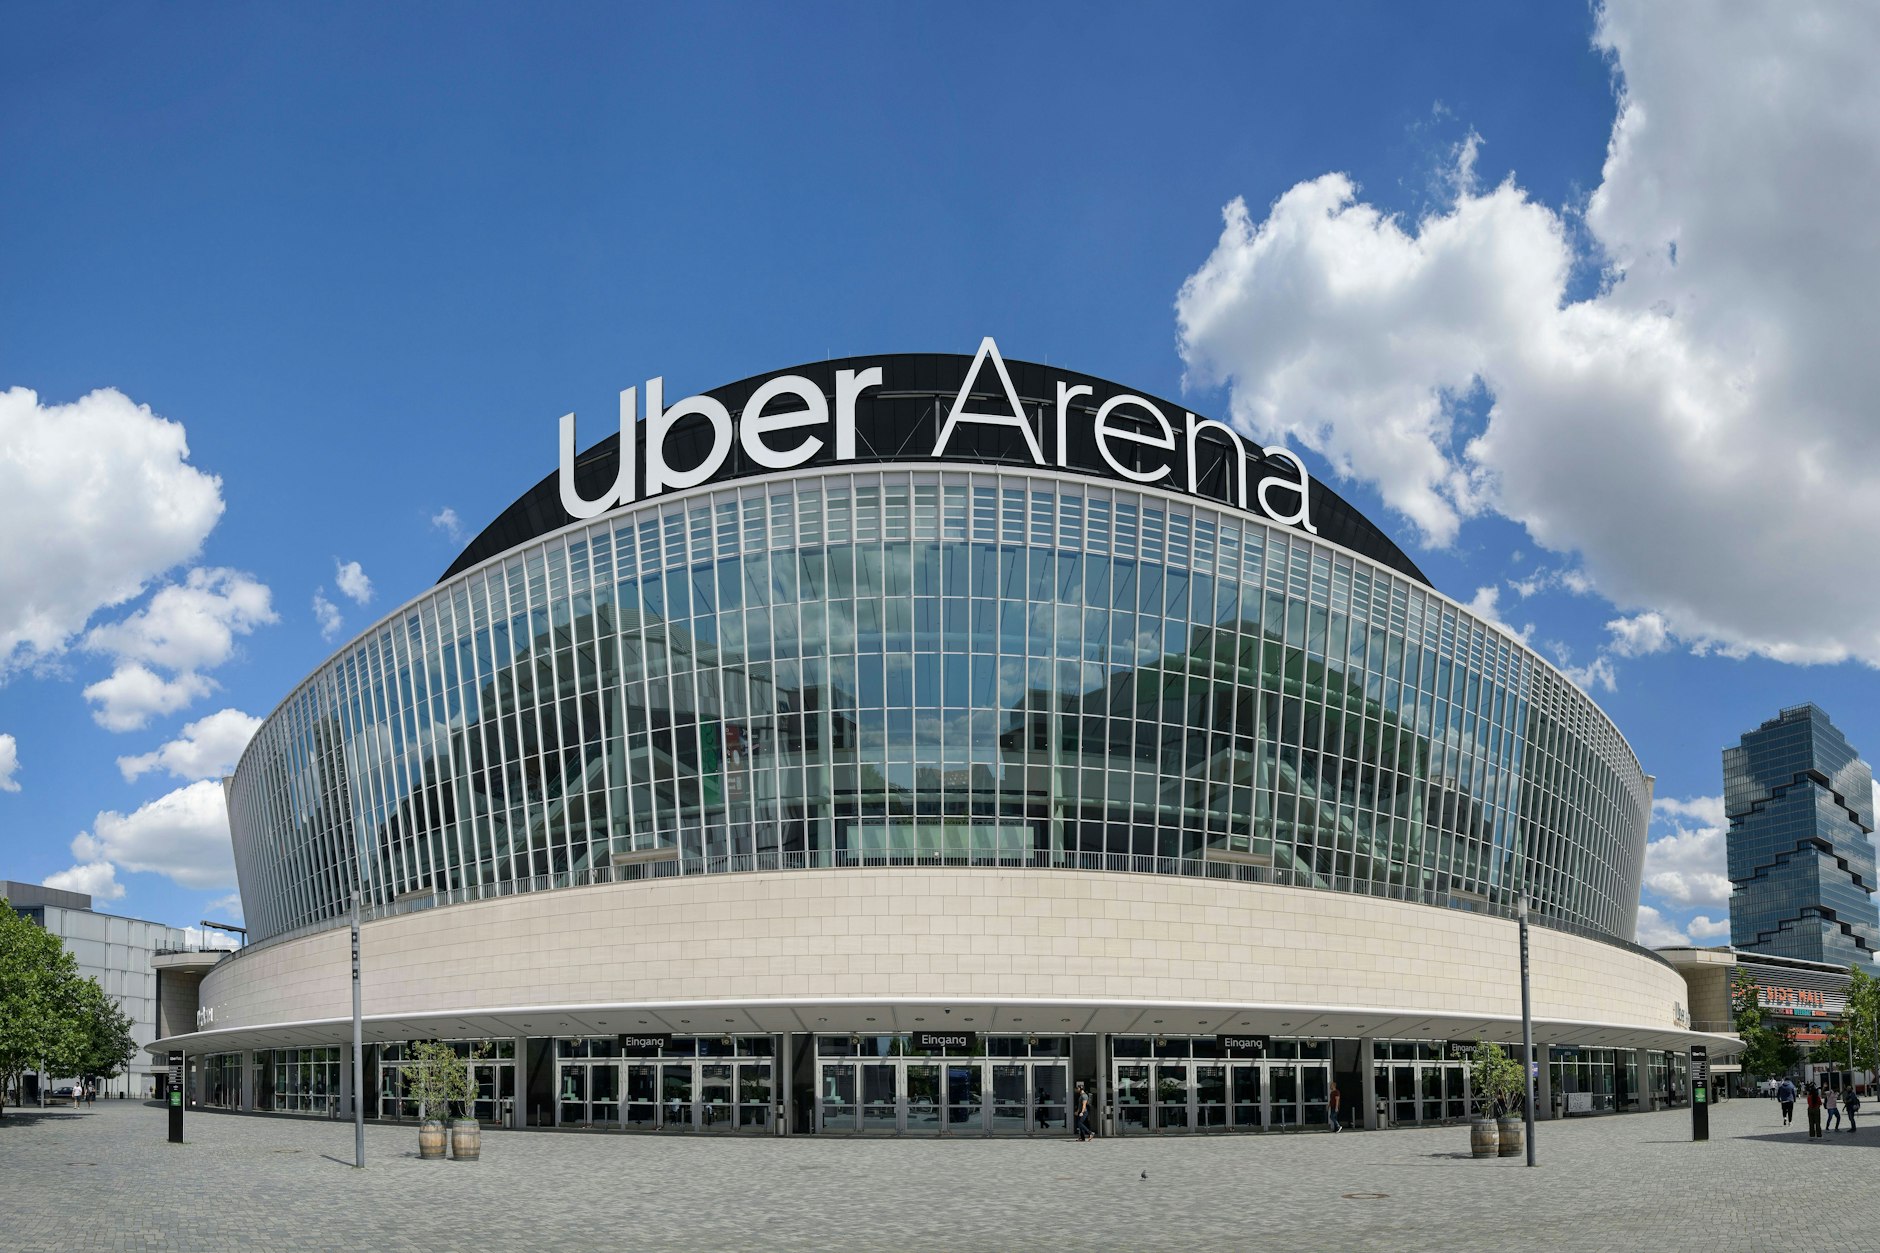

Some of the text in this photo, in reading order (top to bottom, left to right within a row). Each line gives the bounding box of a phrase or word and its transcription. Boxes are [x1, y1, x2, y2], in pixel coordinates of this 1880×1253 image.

[559, 336, 1317, 534] Uber Arena
[1767, 986, 1793, 1002] SIDE
[1799, 990, 1825, 1004] MALL
[626, 1036, 664, 1048] Eingang
[921, 1034, 967, 1047] Eingang
[1224, 1037, 1263, 1049] Eingang
